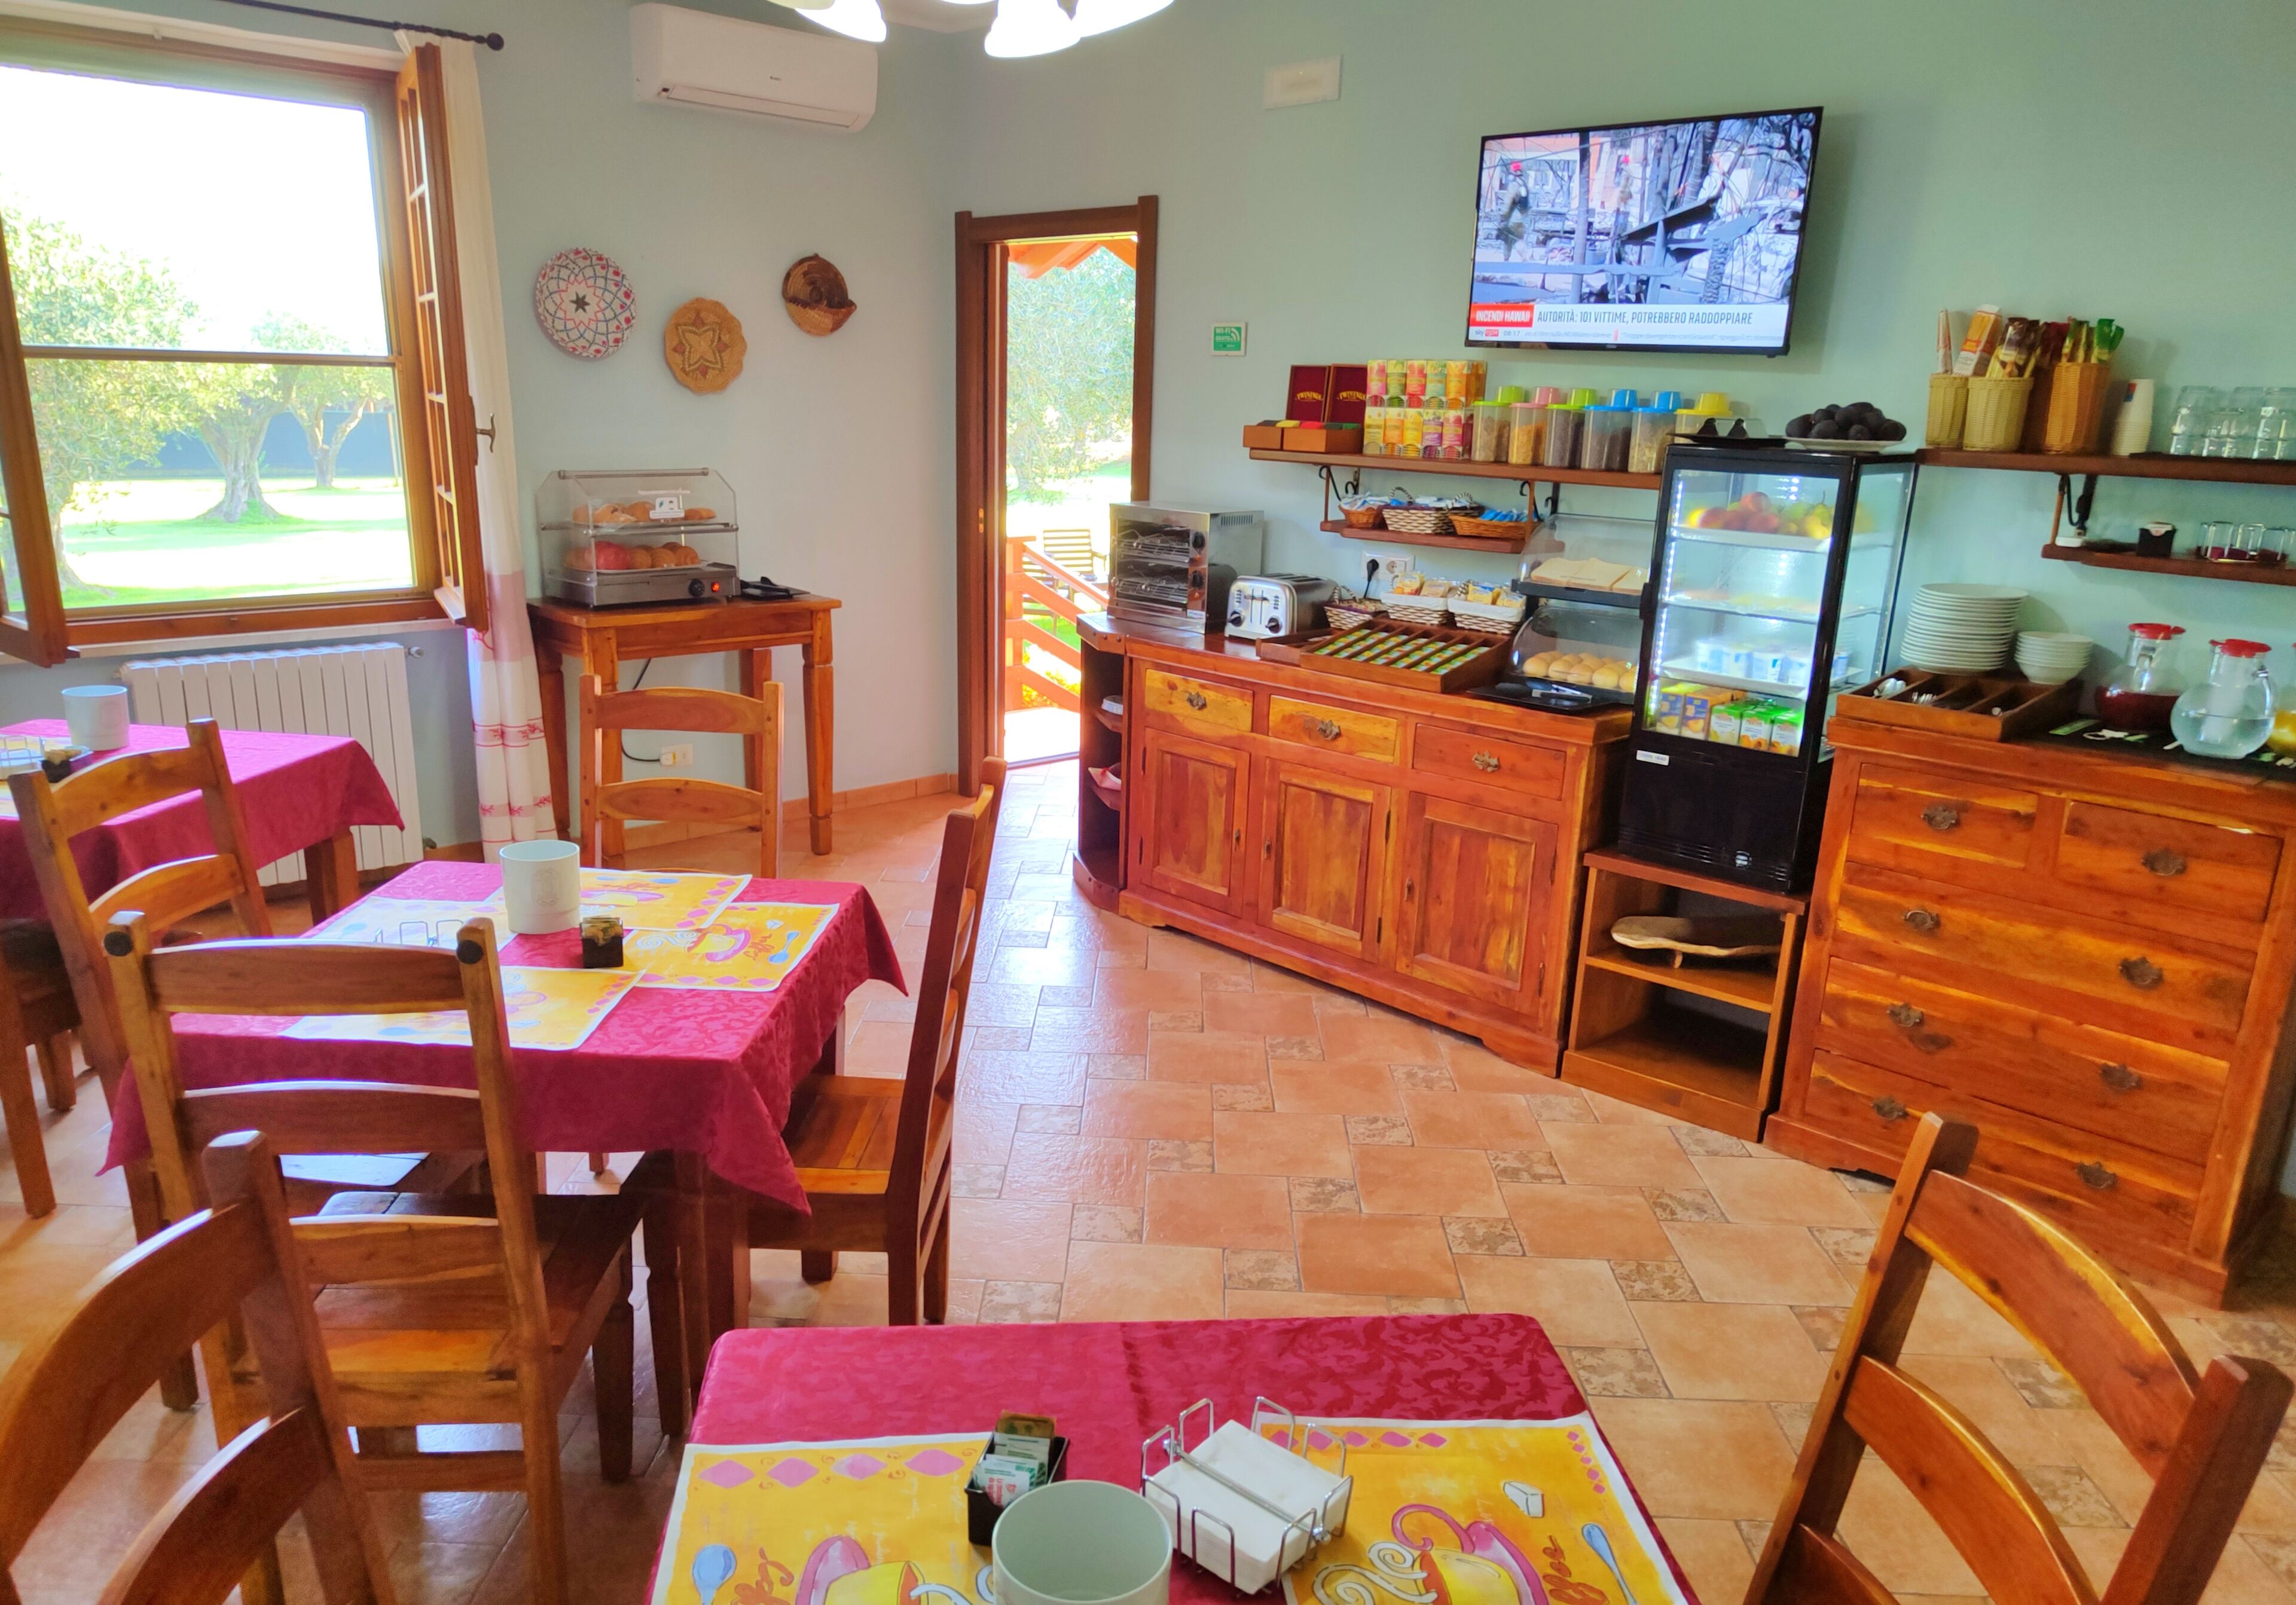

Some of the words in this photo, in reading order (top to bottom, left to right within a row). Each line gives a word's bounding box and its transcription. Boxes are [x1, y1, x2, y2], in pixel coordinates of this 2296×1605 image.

[1477, 310, 1503, 322] INCENDI
[1504, 310, 1530, 323] HAWAII
[1537, 308, 1578, 323] AUTORITÀ:
[1580, 311, 1592, 323] 101
[1593, 311, 1629, 325] VITTIME,
[1631, 311, 1686, 323] POTREBBERO
[1688, 312, 1753, 324] RADDOPPIARE
